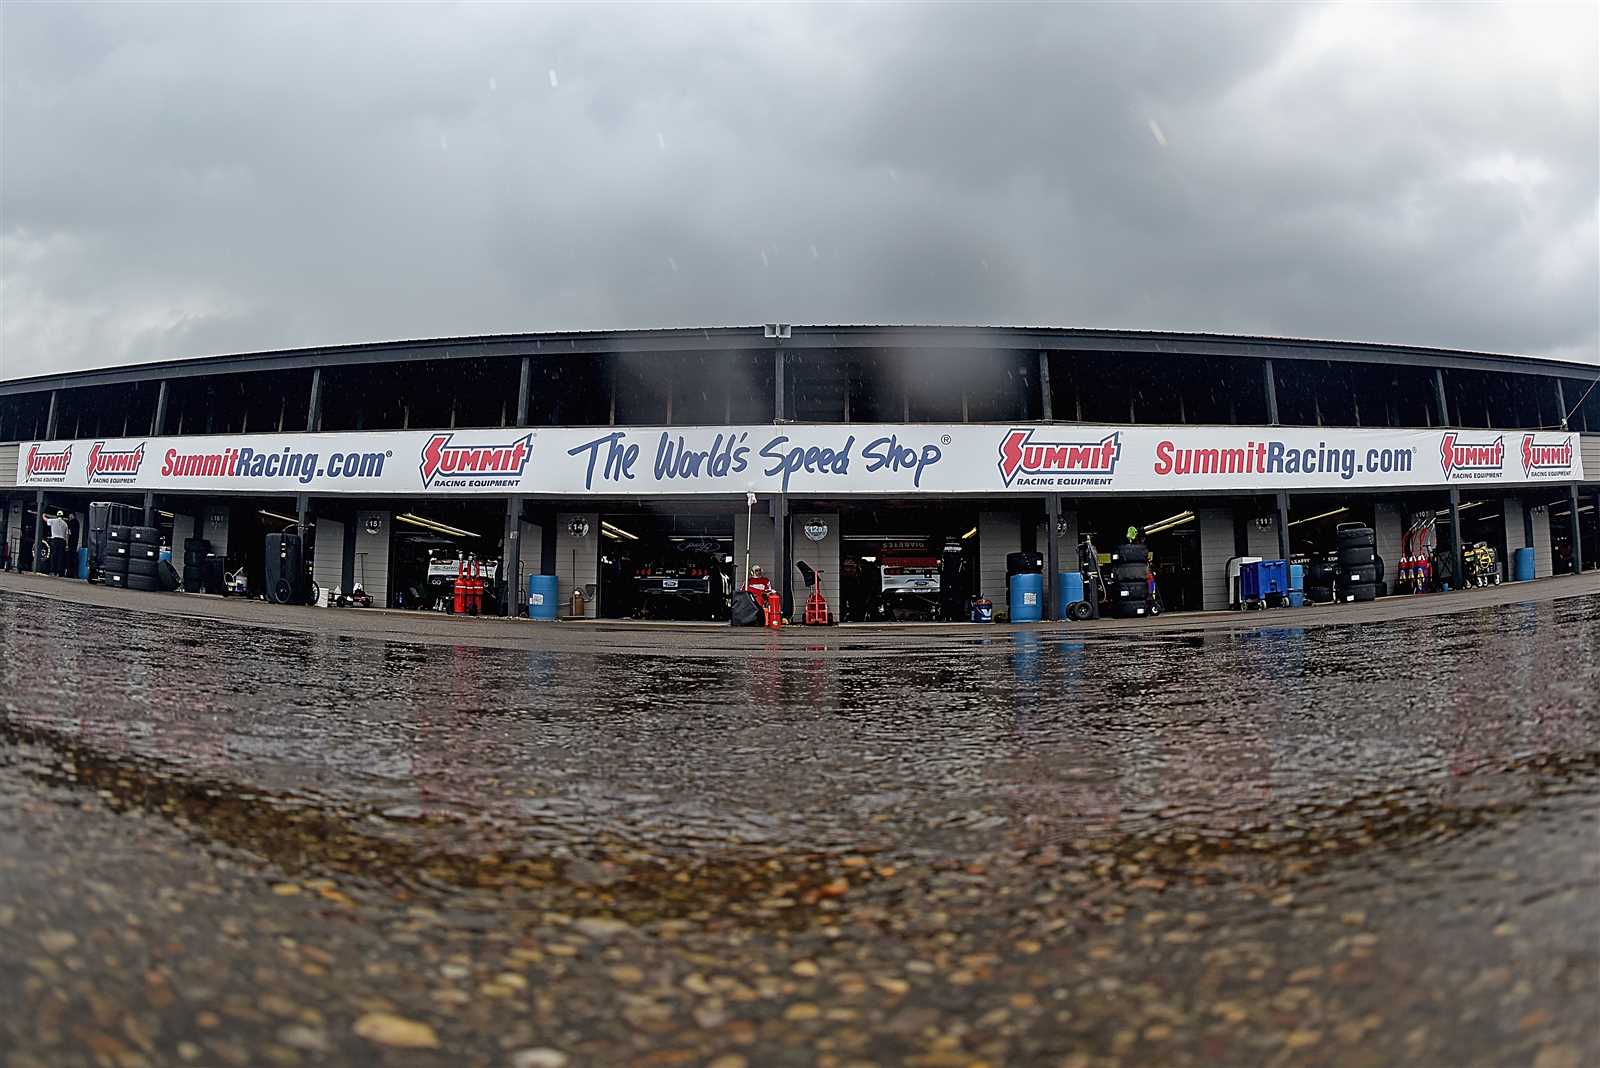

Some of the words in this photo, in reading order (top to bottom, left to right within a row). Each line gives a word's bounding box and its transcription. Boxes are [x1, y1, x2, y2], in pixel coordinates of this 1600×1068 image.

[161, 447, 385, 483] SummitRacing.com
[567, 431, 639, 490] The
[654, 431, 750, 480] World's
[759, 435, 855, 493] Speed
[862, 434, 941, 488] Shop
[1154, 440, 1412, 480] SummitRacing.com
